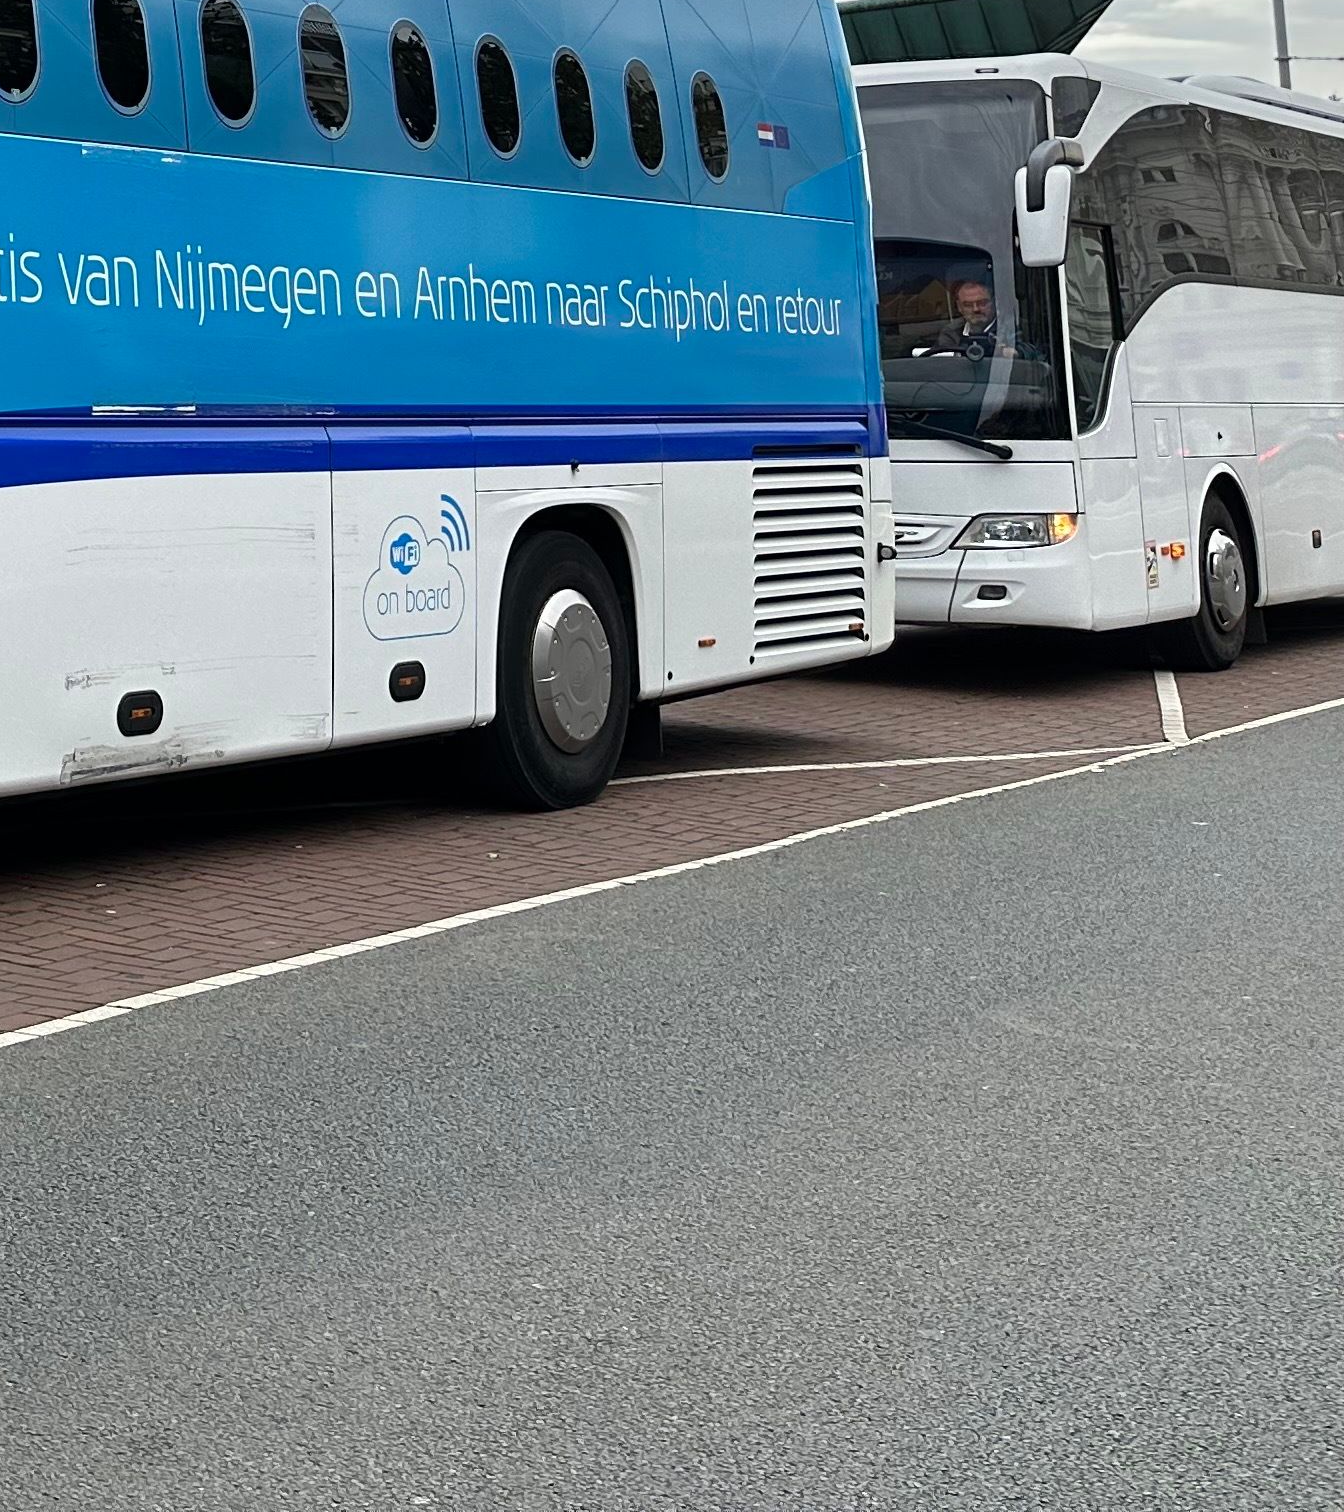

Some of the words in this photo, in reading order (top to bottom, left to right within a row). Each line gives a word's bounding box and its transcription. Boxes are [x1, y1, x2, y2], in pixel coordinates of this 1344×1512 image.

[58, 253, 138, 307] van
[155, 244, 342, 329] Nijmegen
[355, 271, 400, 319] en
[414, 263, 537, 324] Arnhem
[546, 281, 609, 327] naar
[618, 275, 730, 343] Schiphol
[738, 293, 769, 334] en
[775, 288, 841, 336] retour
[377, 592, 399, 616] on
[406, 580, 450, 613] board
